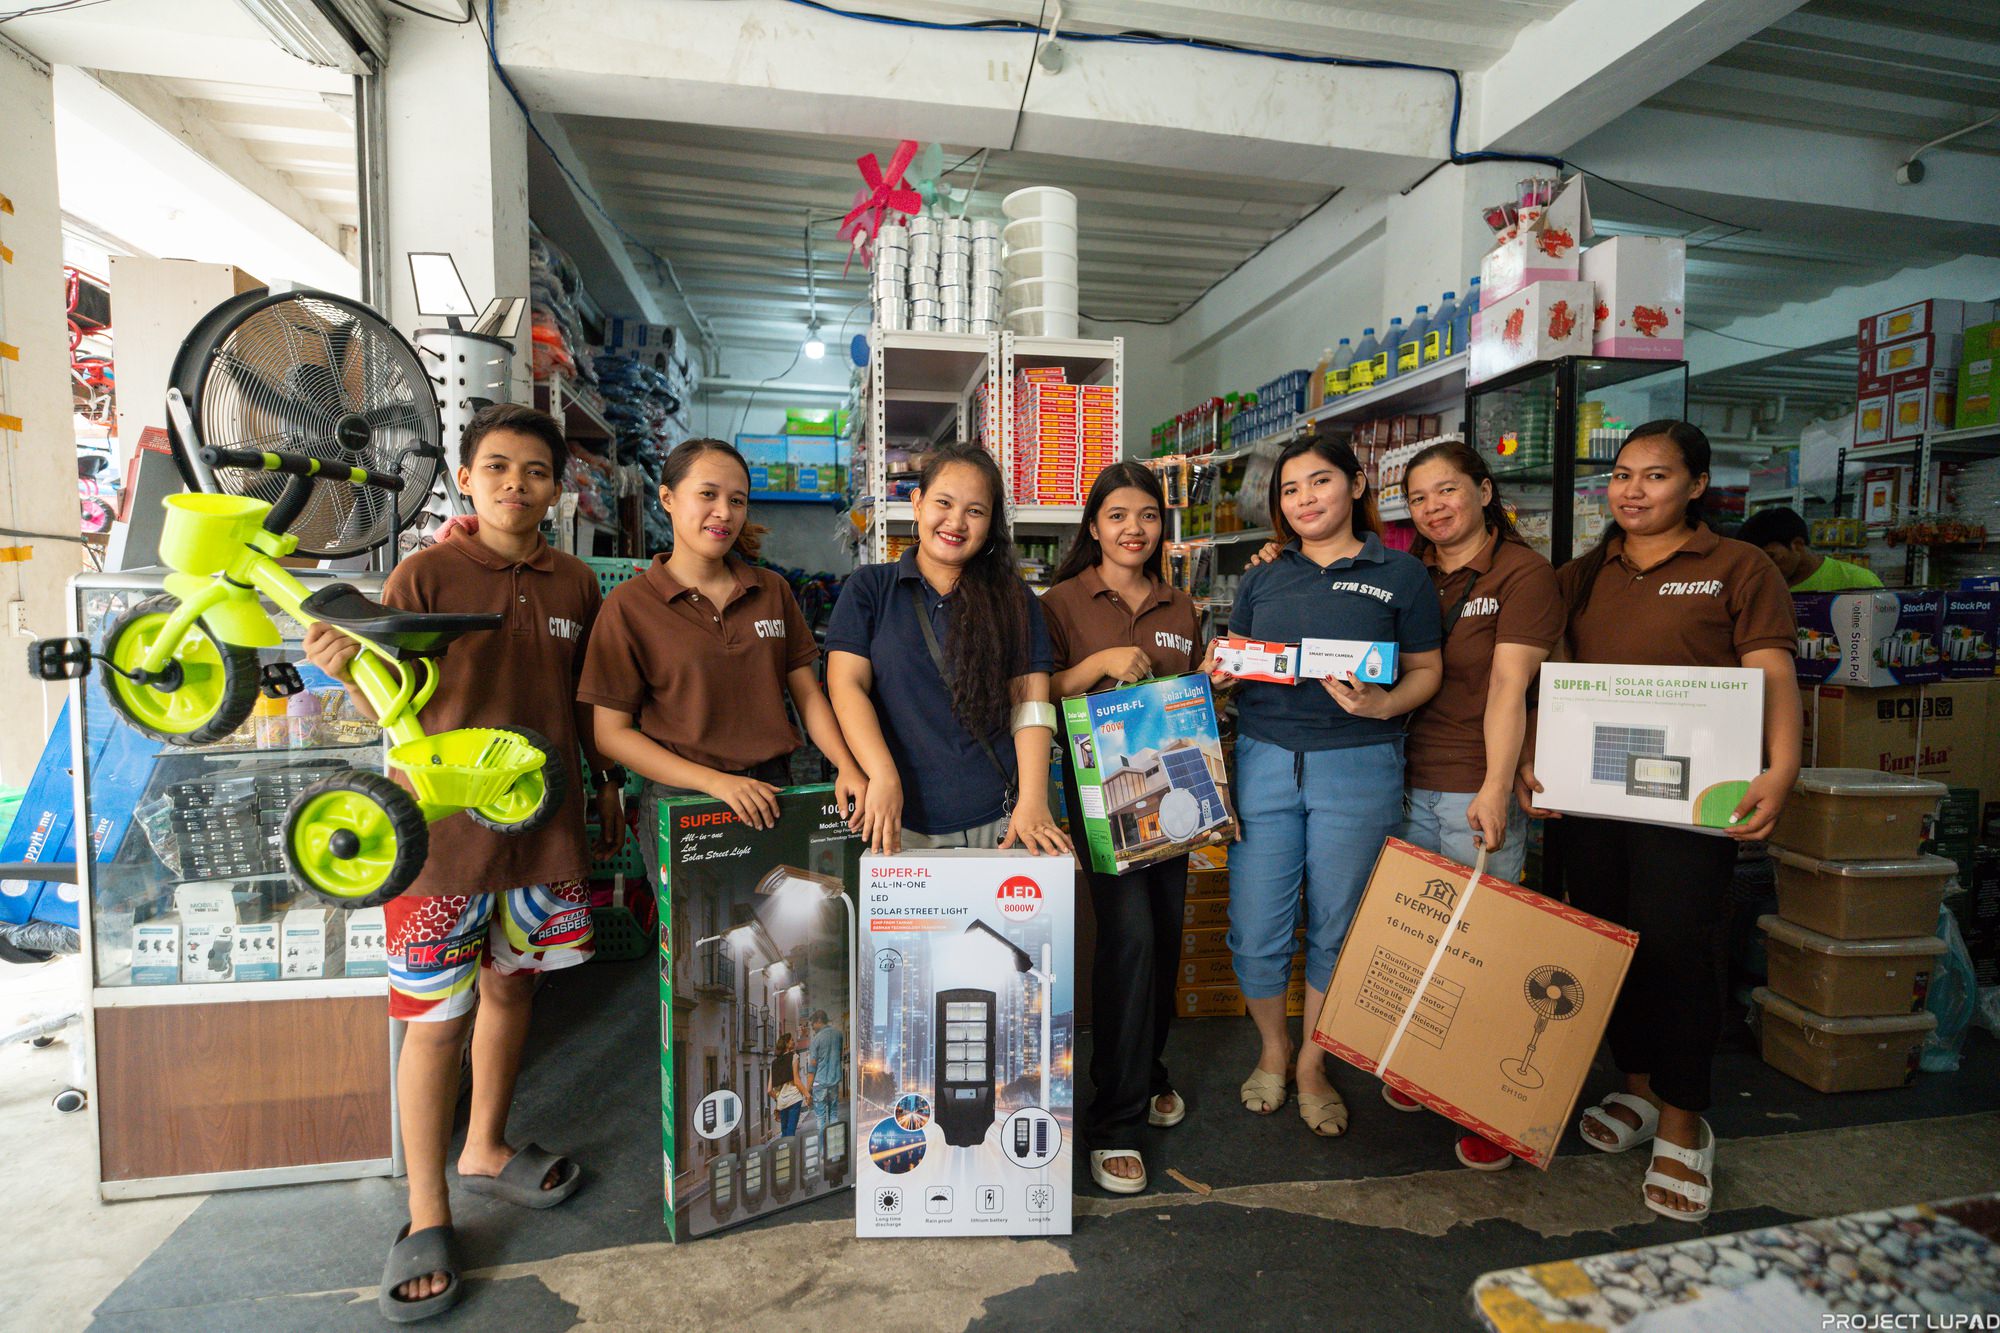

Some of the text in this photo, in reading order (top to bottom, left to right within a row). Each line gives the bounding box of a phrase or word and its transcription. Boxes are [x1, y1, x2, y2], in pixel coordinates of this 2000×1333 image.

[1332, 581, 1394, 603] CTM STAFF
[1659, 582, 1688, 596] CTM
[1902, 603, 1938, 613] Stock Pot
[1950, 602, 1991, 611] Stock Pot
[549, 616, 570, 639] CTM
[754, 619, 776, 638] CTM
[1155, 631, 1193, 657] CTM STAFF
[1851, 632, 1861, 662] Stock
[1850, 664, 1860, 682] Pot
[1554, 679, 1608, 692] SUPER-FL
[1615, 677, 1749, 690] SOLAR GARDEN LIGHT
[1163, 686, 1205, 703] Solar Light
[1615, 688, 1689, 699] SOLAR LIGHT
[1096, 700, 1145, 717] SUPER-FL
[1101, 720, 1125, 734] 700W
[680, 811, 741, 829] SUPER-
[681, 846, 751, 863] Solar Street Light
[871, 867, 932, 878] SUPER-FL
[871, 881, 926, 889] ALL-IN-ONE
[1003, 886, 1036, 899] LED
[562, 909, 585, 922] TEAM
[871, 907, 969, 915] SOLAR STREET LIGHT
[1004, 904, 1035, 913] 8000W
[538, 918, 592, 941] REDSPEED
[1387, 916, 1484, 968] 16 Inch Stnd Fan
[1380, 962, 1421, 985] High Quali
[1385, 953, 1445, 986] Quality marial
[1373, 981, 1403, 1001] long life
[1377, 971, 1445, 1011] Pure coppe motor
[1369, 991, 1444, 1035] Low noise fficiency
[1370, 1004, 1397, 1023] speeds
[1501, 1084, 1528, 1102] EH100
